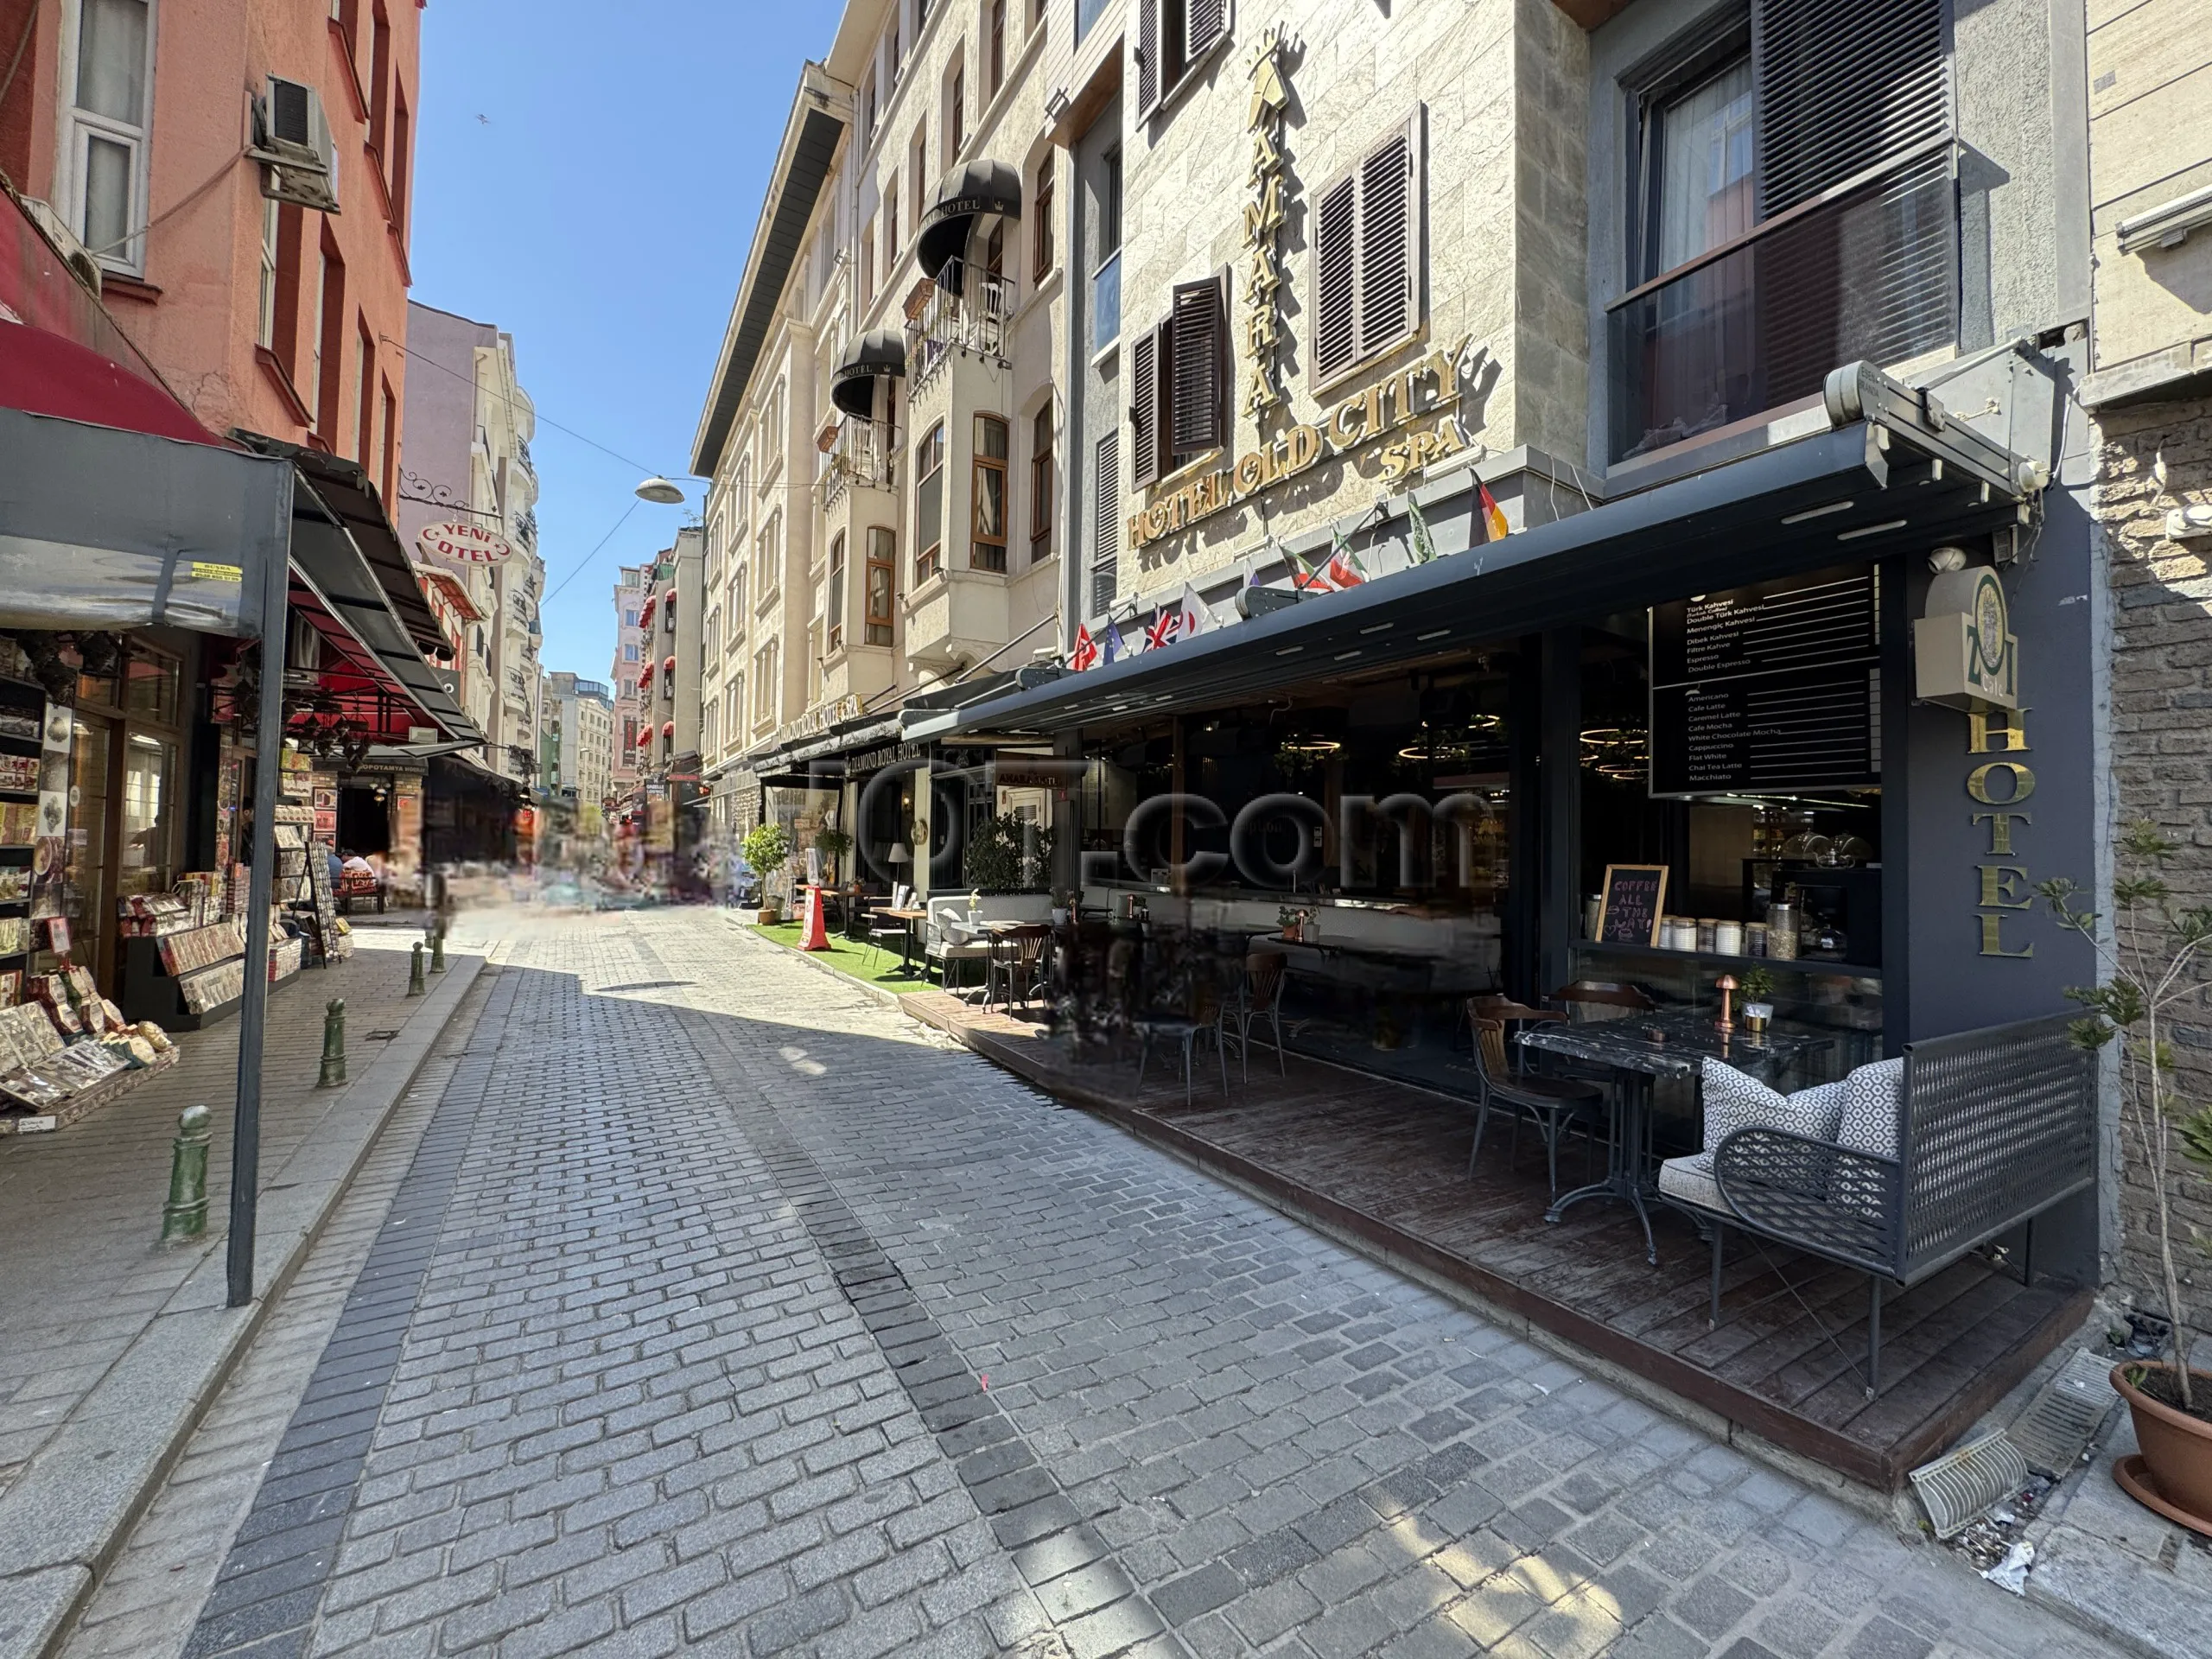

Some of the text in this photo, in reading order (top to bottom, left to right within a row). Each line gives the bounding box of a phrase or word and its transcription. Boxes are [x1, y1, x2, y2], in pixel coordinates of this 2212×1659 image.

[941, 200, 980, 216] HOTEL
[1242, 125, 1286, 419] AMARA
[1127, 333, 1472, 549] HOTEL OLD CITY
[1381, 415, 1469, 482] SPA
[437, 540, 499, 563] OTEL
[1705, 599, 1733, 609] Kahvesi
[1688, 614, 1713, 624] Double
[1733, 604, 1764, 615] Kahvesi
[1688, 617, 1755, 633] Menengiç Kahvesi
[1688, 632, 1738, 645] Dibek Kahvesi
[1688, 642, 1730, 654] Filtre Kahve
[1688, 654, 1719, 664] Espresso
[1688, 658, 1751, 672] Double Espresso
[1688, 693, 1728, 702] Americano
[1688, 734, 1710, 742] White
[1712, 730, 1751, 739] Chocolate
[1688, 742, 1733, 752] Cappuccino
[851, 742, 921, 773] DIAMOND ROYAL HOTEL
[1689, 773, 1732, 782] Macchiato
[1966, 708, 2036, 959] HOTEL
[1614, 880, 1657, 892] COFFEE
[1618, 894, 1644, 906] ALL
